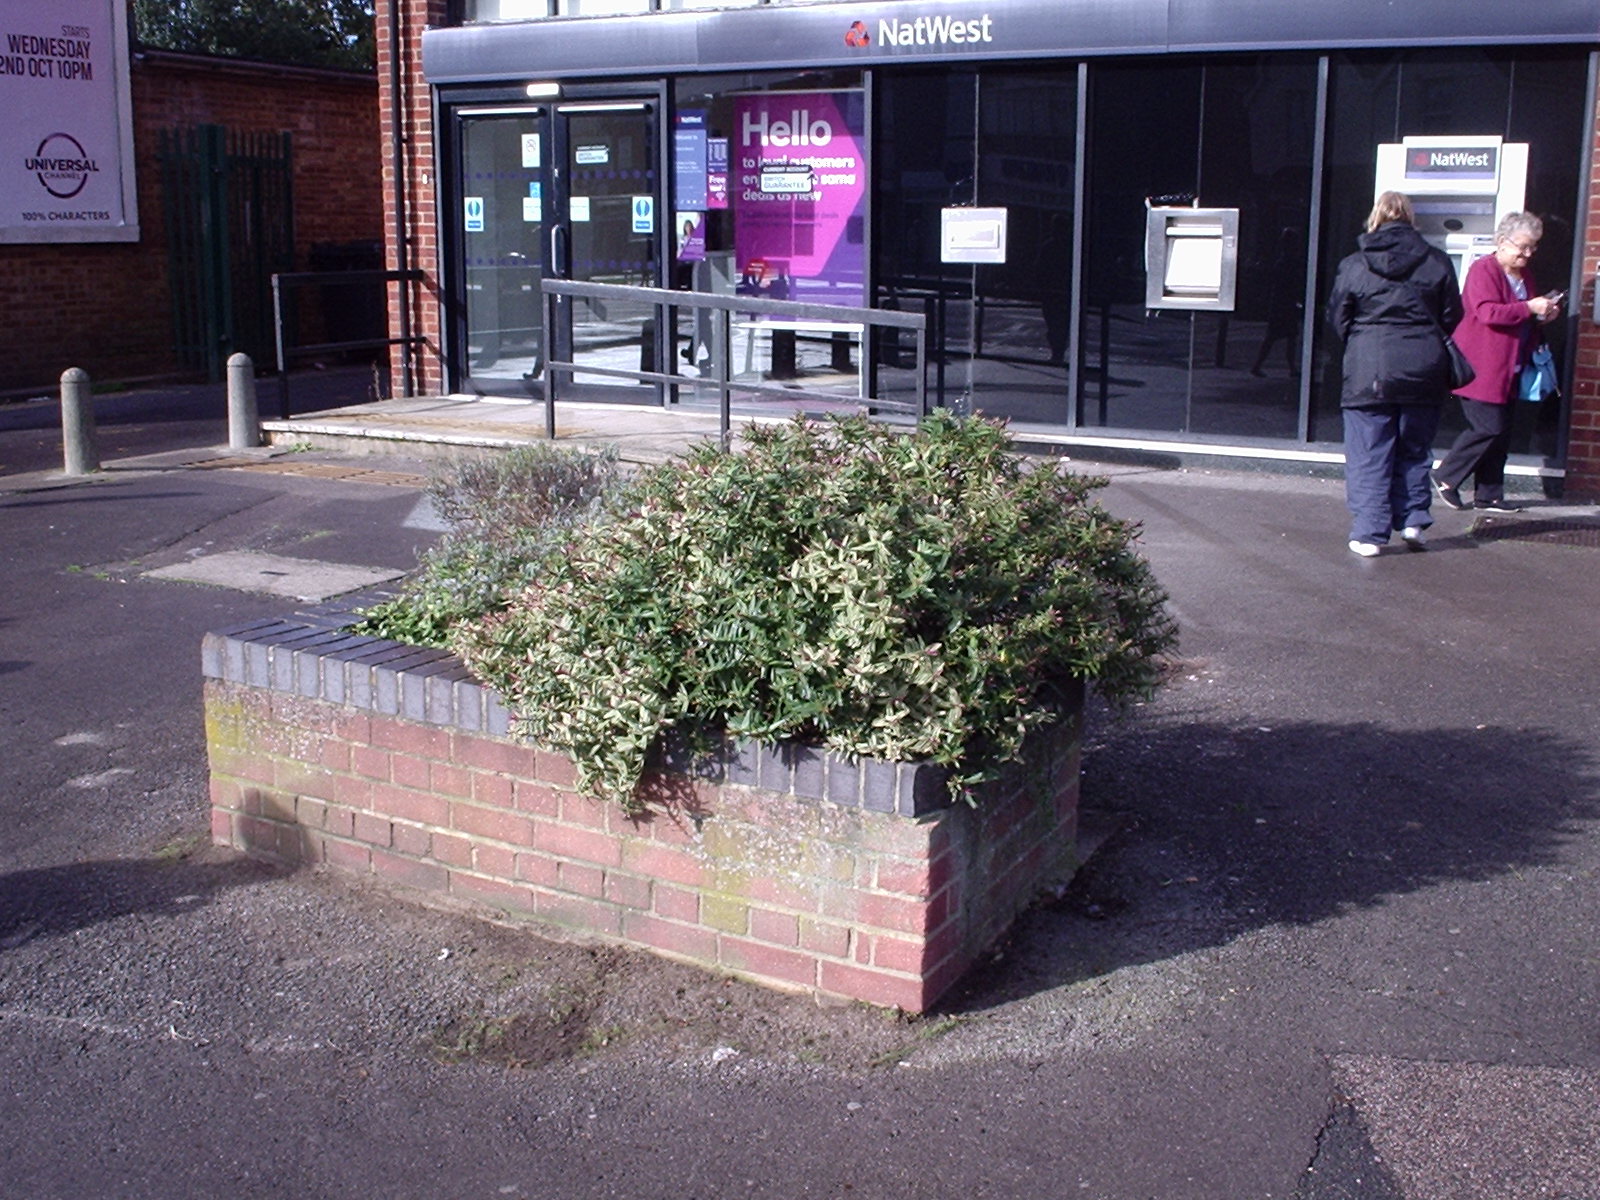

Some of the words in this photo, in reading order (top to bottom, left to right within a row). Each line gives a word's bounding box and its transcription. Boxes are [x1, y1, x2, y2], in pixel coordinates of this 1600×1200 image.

[61, 24, 90, 39] STARTS
[878, 13, 993, 47] NatWest
[7, 34, 92, 60] WEDNESDAY
[29, 58, 54, 79] OCT
[57, 60, 93, 81] 10PM
[742, 109, 833, 147] Hello
[25, 158, 99, 172] UNIVERSAL
[742, 157, 756, 169] to
[1430, 152, 1489, 167] NatWest
[44, 171, 82, 180] CHANNEL
[22, 211, 46, 222] 100%
[48, 211, 110, 222] CHARACTERS
